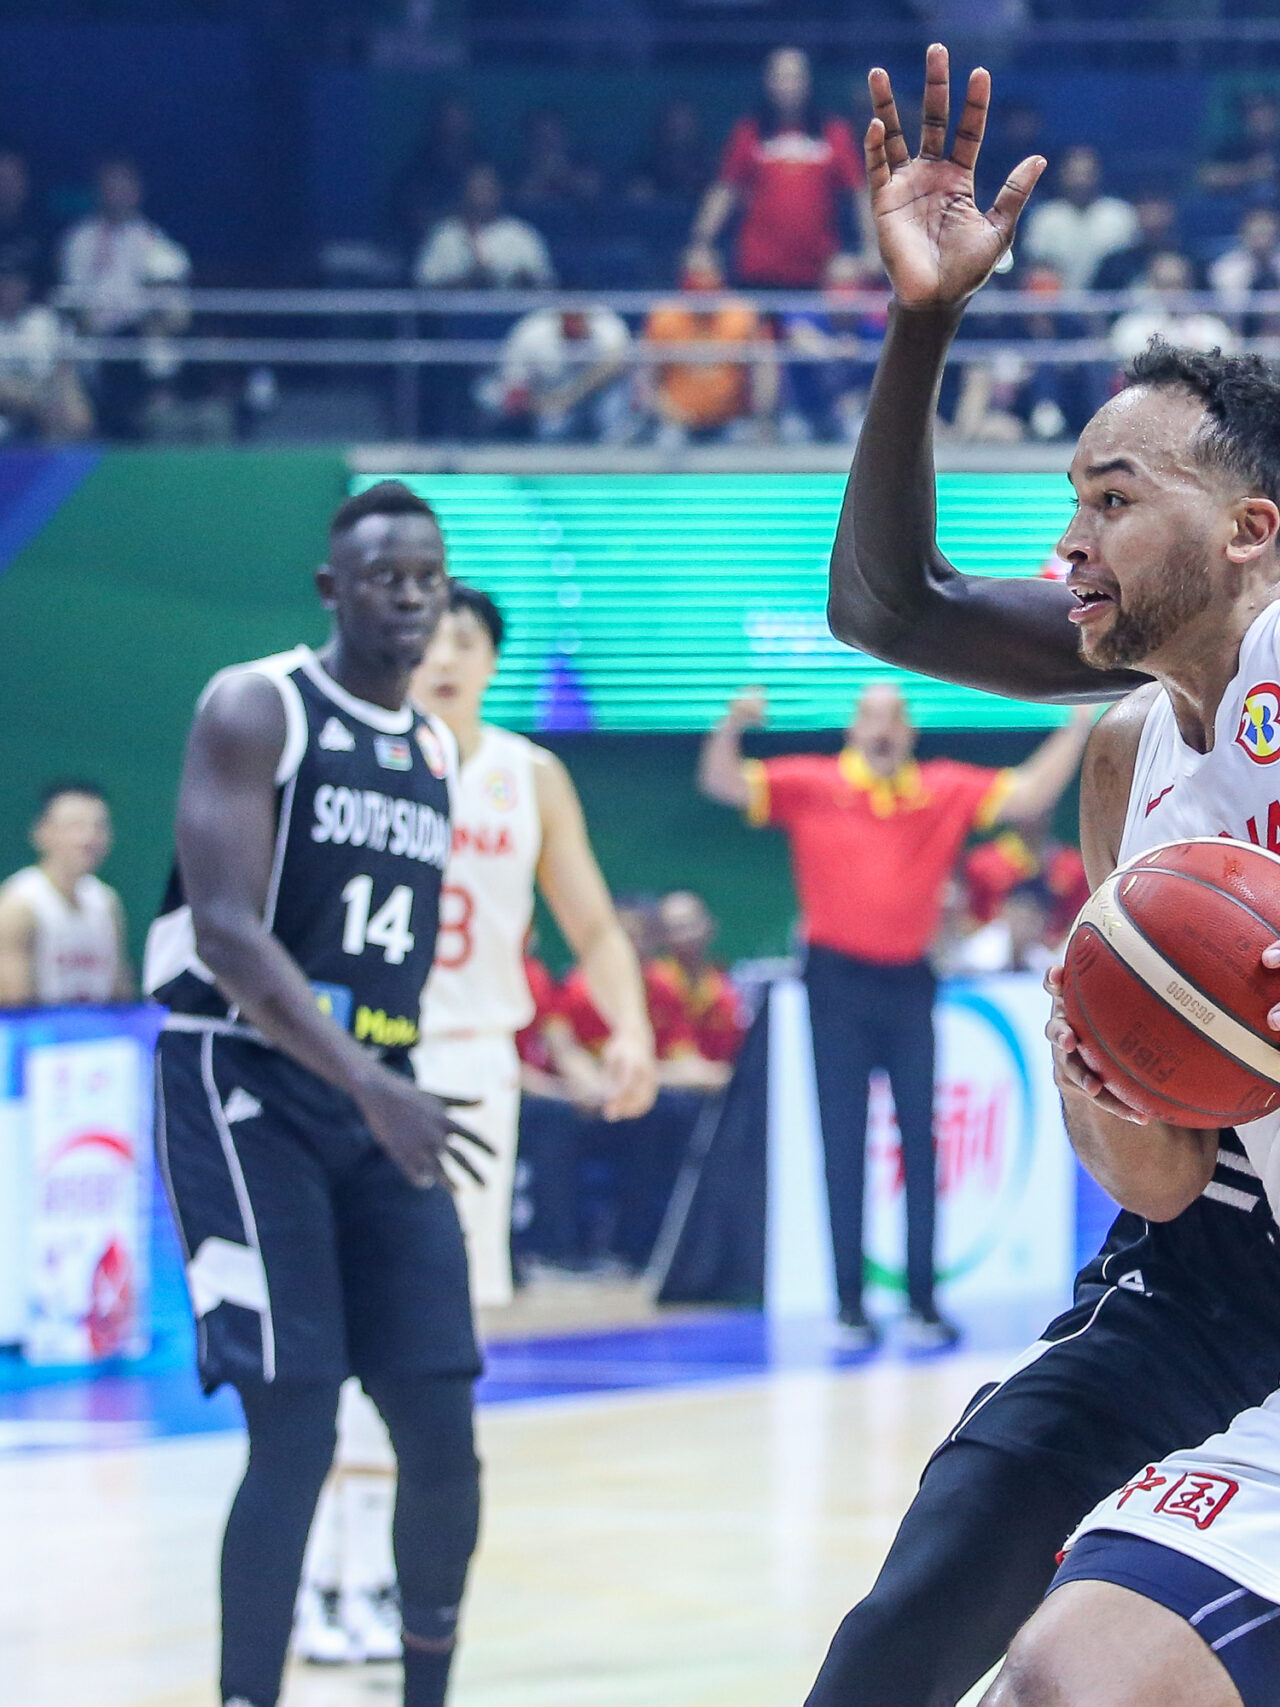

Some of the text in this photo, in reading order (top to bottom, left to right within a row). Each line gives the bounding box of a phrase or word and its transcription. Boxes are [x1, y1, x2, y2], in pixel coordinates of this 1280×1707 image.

[311, 784, 392, 851] SOUTH
[340, 873, 415, 965] 14
[1166, 980, 1215, 1025] BG5000
[1118, 1032, 1177, 1084] FIBA
[1117, 1466, 1239, 1530] 中国
